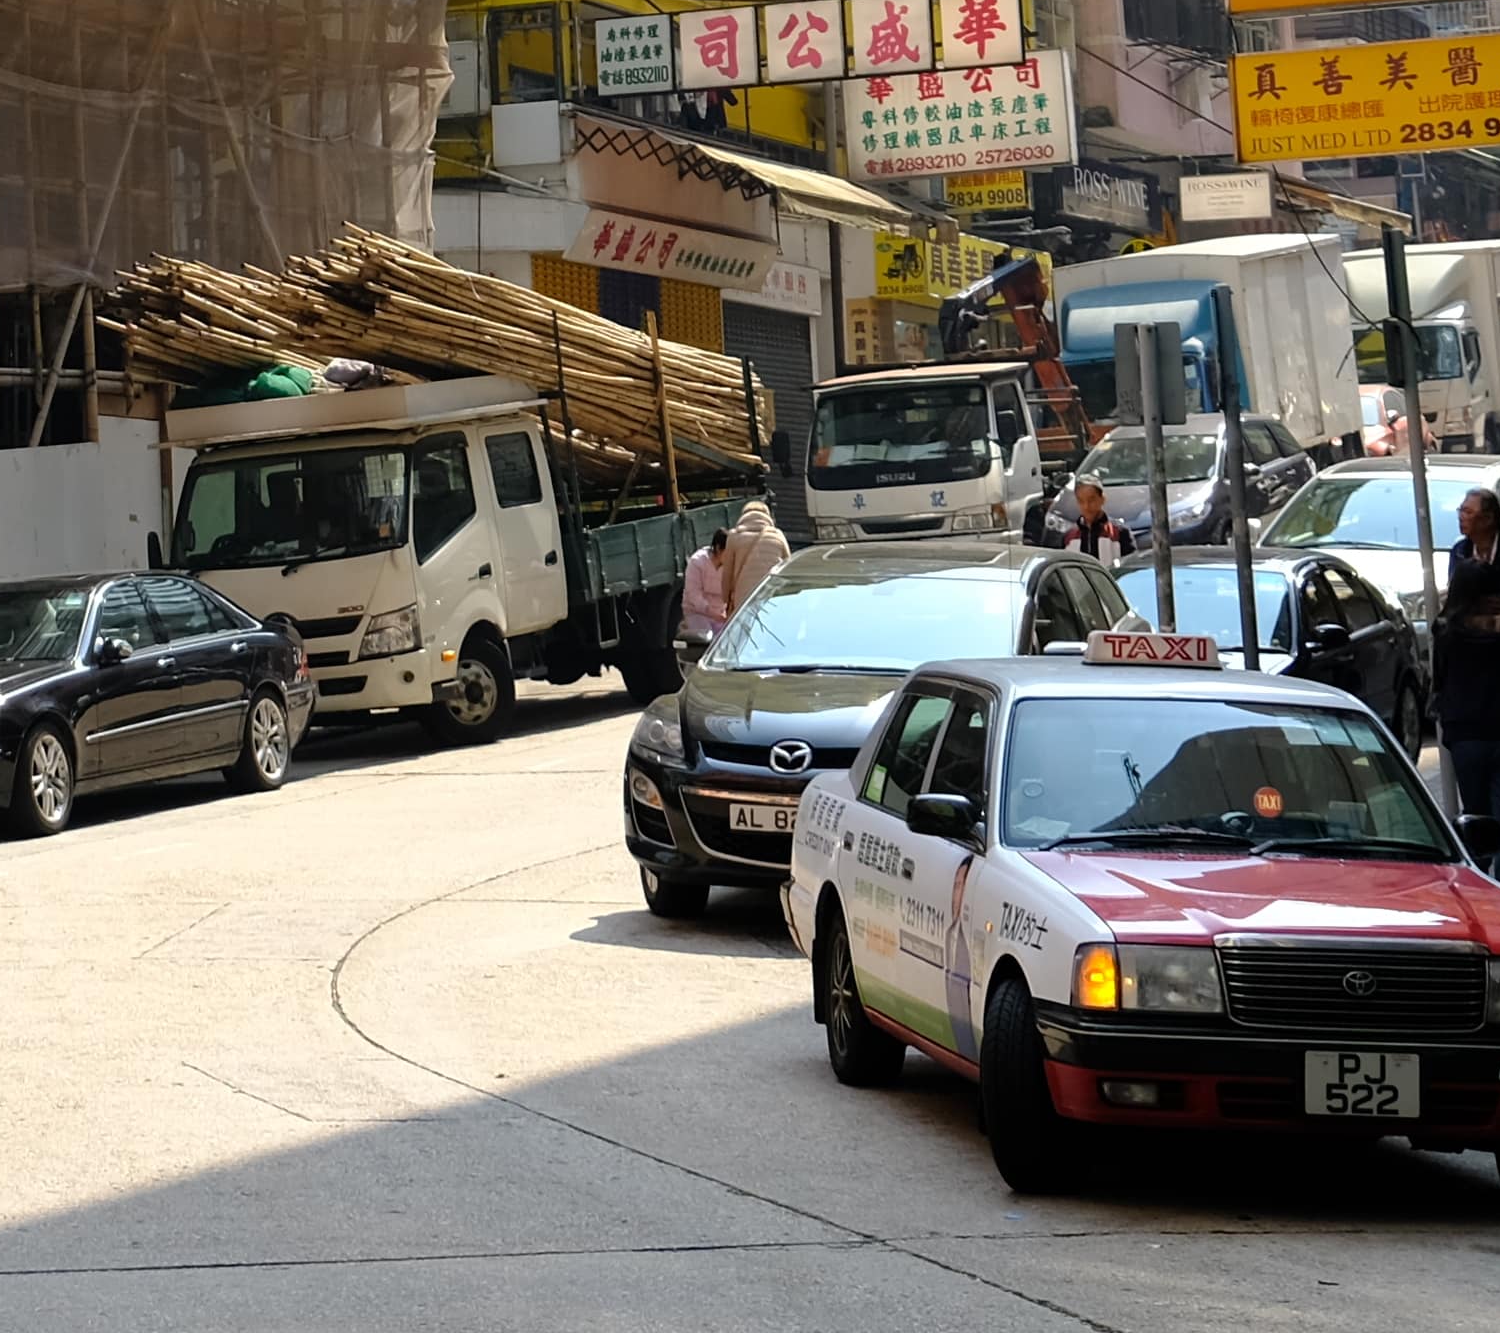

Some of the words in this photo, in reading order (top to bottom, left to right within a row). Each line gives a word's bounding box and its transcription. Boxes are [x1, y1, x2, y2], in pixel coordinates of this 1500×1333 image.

[1250, 134, 1296, 156] JUST
[1301, 131, 1348, 151] MED
[1352, 127, 1392, 148] LTD
[1400, 119, 1474, 144] 2834
[975, 144, 1055, 166] 25726030
[949, 189, 984, 207] 2834
[988, 187, 1025, 205] 9908
[1073, 166, 1111, 203] ROSS
[1116, 176, 1150, 211] WINE
[876, 471, 916, 484] ISUZU
[1104, 635, 1210, 662] TAXI
[1256, 794, 1281, 811] TAXI
[735, 807, 763, 828] AL
[1337, 1053, 1387, 1085] PJ
[1325, 1083, 1400, 1115] 522
